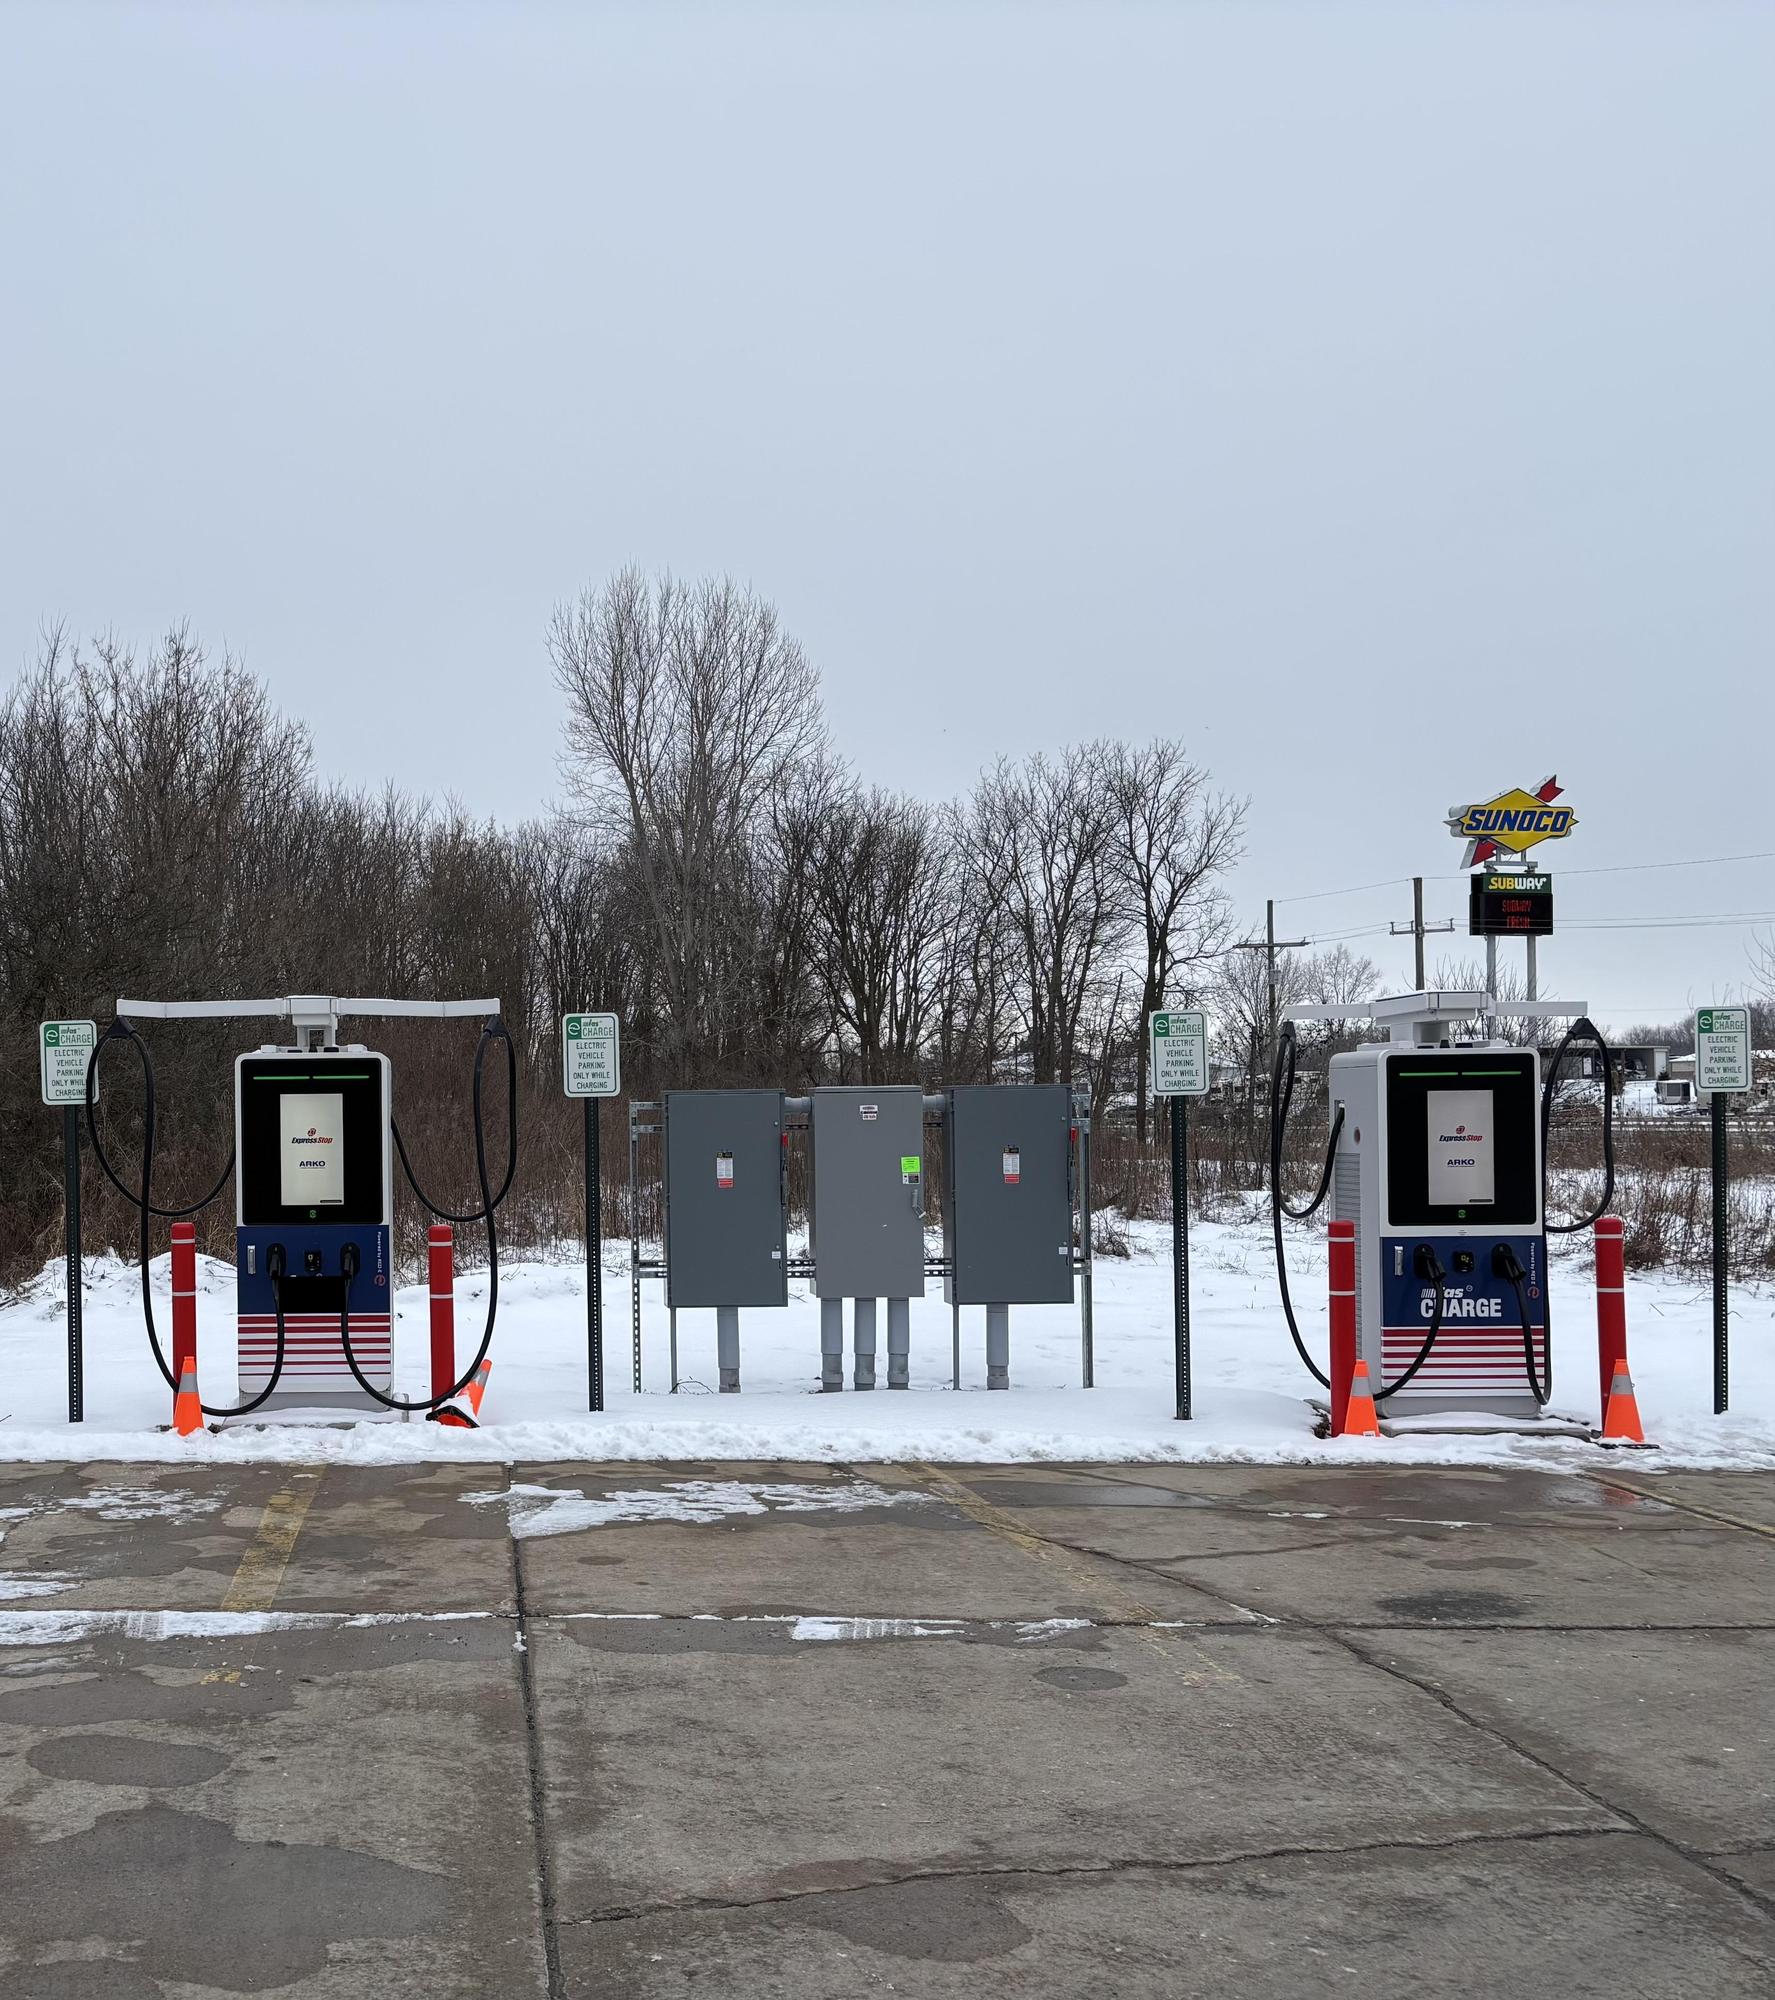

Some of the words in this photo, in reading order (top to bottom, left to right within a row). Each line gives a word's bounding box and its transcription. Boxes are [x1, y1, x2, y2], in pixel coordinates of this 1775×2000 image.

[1465, 809, 1571, 833] SUNOCO
[1488, 877, 1547, 890] SUBWAY
[1502, 900, 1532, 912] SUBWAY
[1506, 916, 1530, 928] FRESH
[1170, 1024, 1202, 1034] CHARGE
[1714, 1021, 1745, 1030] CHARGE
[582, 1027, 613, 1037] CHARGE
[60, 1034, 92, 1044] CHARGE
